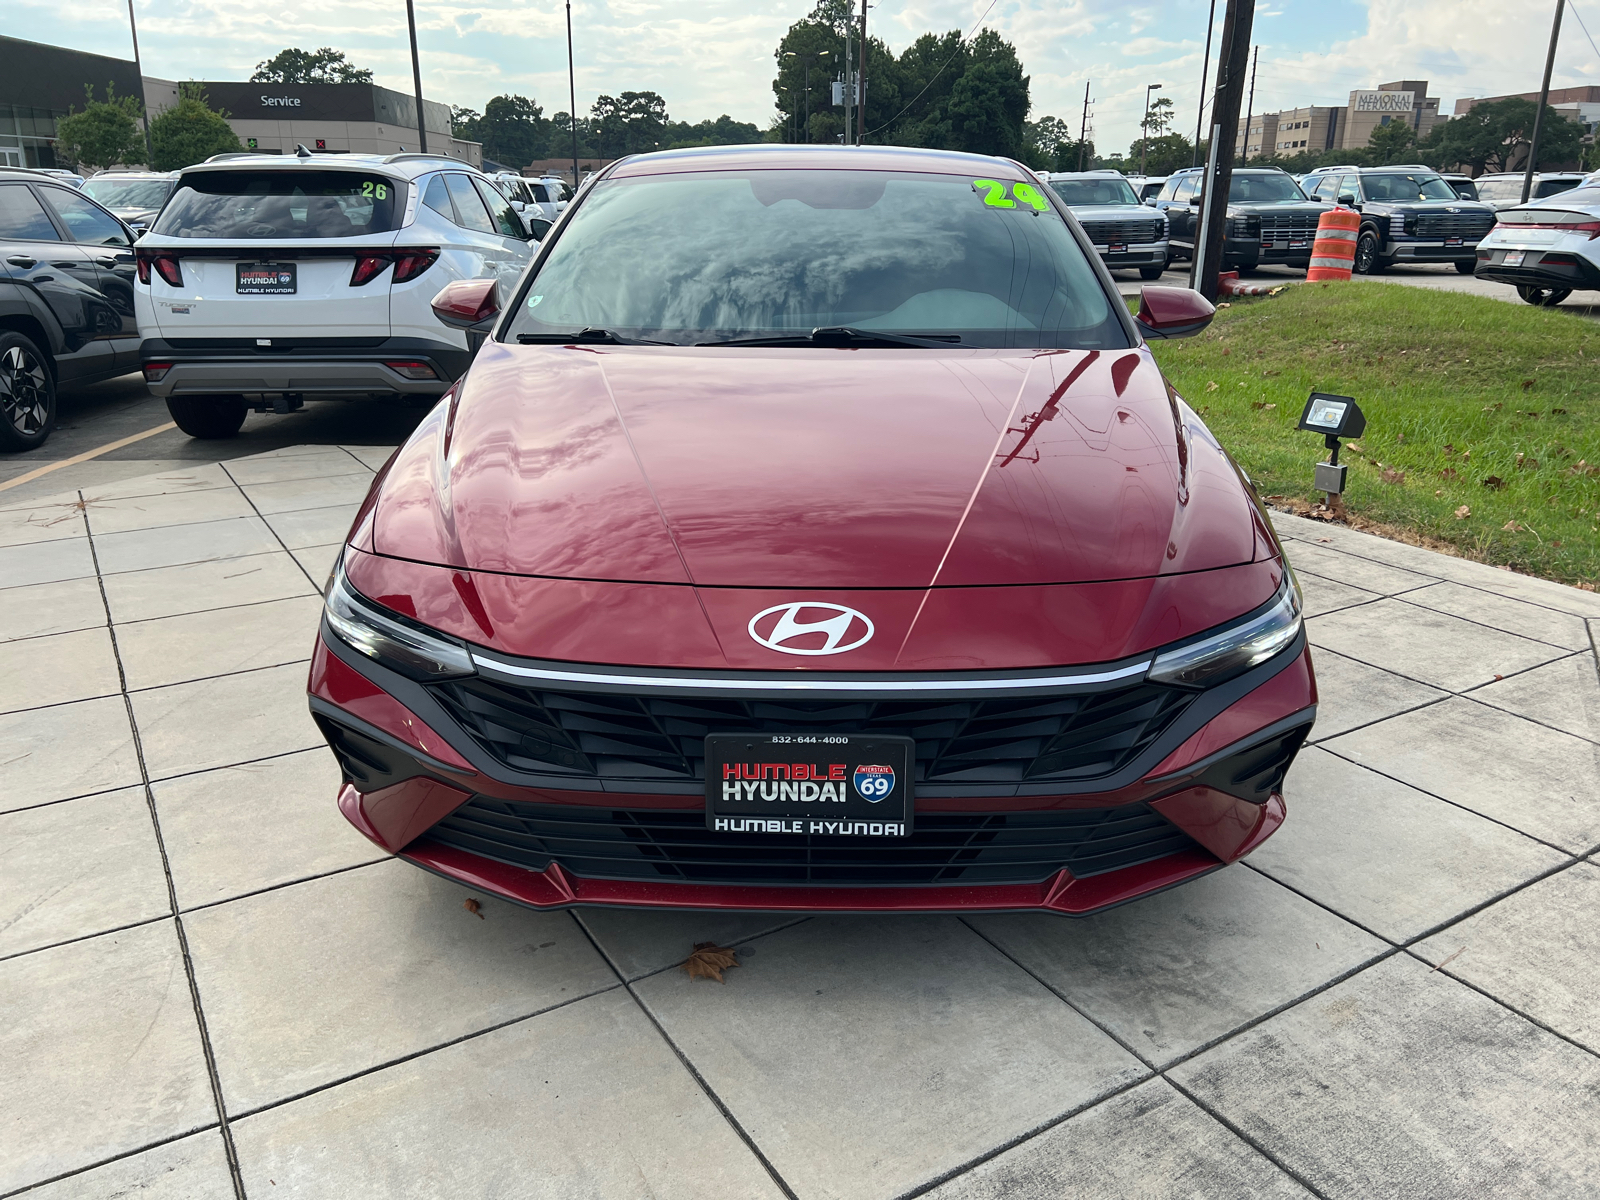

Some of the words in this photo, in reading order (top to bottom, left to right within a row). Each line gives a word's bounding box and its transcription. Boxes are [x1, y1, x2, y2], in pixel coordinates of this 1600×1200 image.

[260, 95, 301, 107] Service
[1357, 102, 1411, 110] HERMANN
[1360, 94, 1411, 103] MEMORIAL
[361, 181, 387, 200] 26
[973, 179, 1051, 212] 24
[280, 275, 290, 283] 69
[772, 736, 849, 744] 832-644-4000
[722, 763, 847, 781] HUMBLE
[722, 781, 847, 803] HYUNDAI
[860, 778, 889, 796] 69
[714, 818, 803, 833] HUMBLE
[809, 821, 905, 836] HYUNDAI
